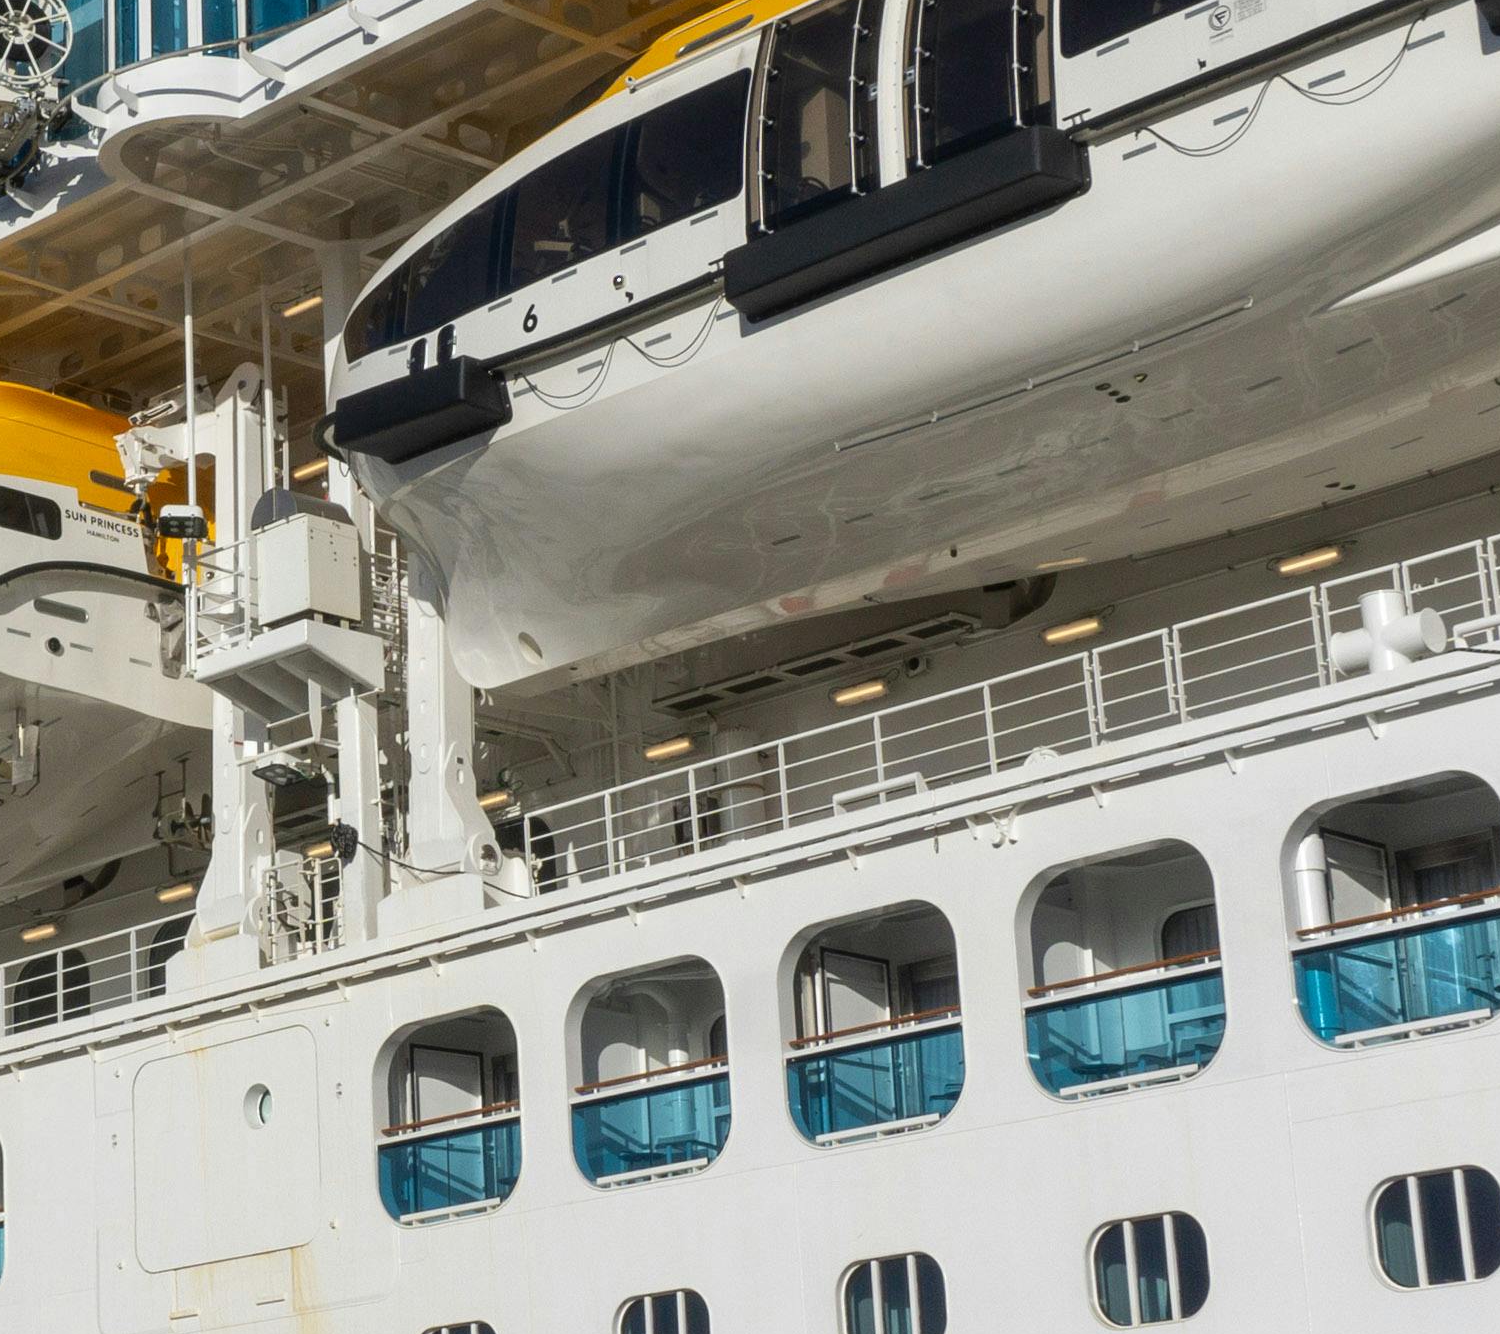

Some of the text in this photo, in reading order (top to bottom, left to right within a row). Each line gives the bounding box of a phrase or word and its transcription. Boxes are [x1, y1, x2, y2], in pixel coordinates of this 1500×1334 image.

[522, 303, 538, 333] 6
[64, 509, 139, 538] SUN PRINCESS
